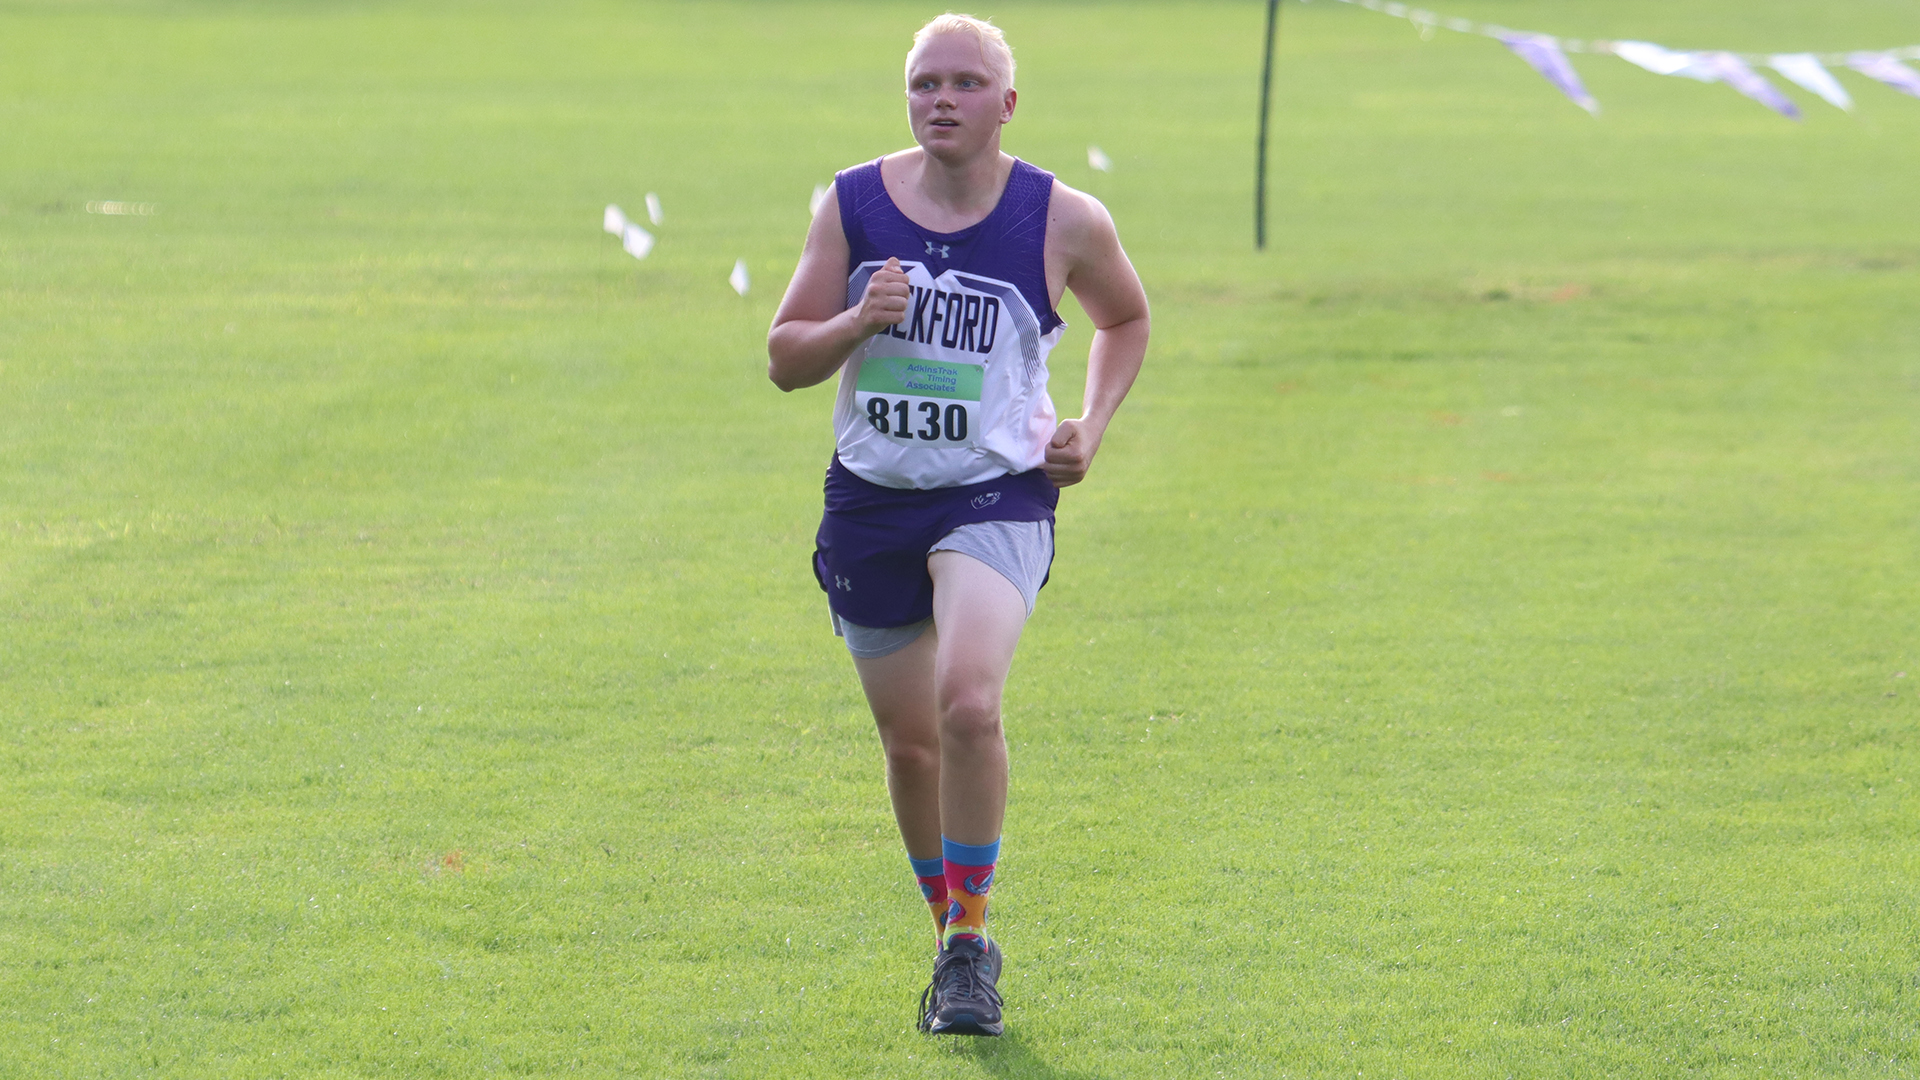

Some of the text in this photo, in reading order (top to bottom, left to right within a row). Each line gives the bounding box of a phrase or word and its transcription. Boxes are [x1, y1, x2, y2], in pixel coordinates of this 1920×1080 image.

[877, 284, 999, 354] KFORD
[905, 381, 956, 393] Associates
[927, 373, 957, 385] Timing
[867, 397, 967, 441] 8130
